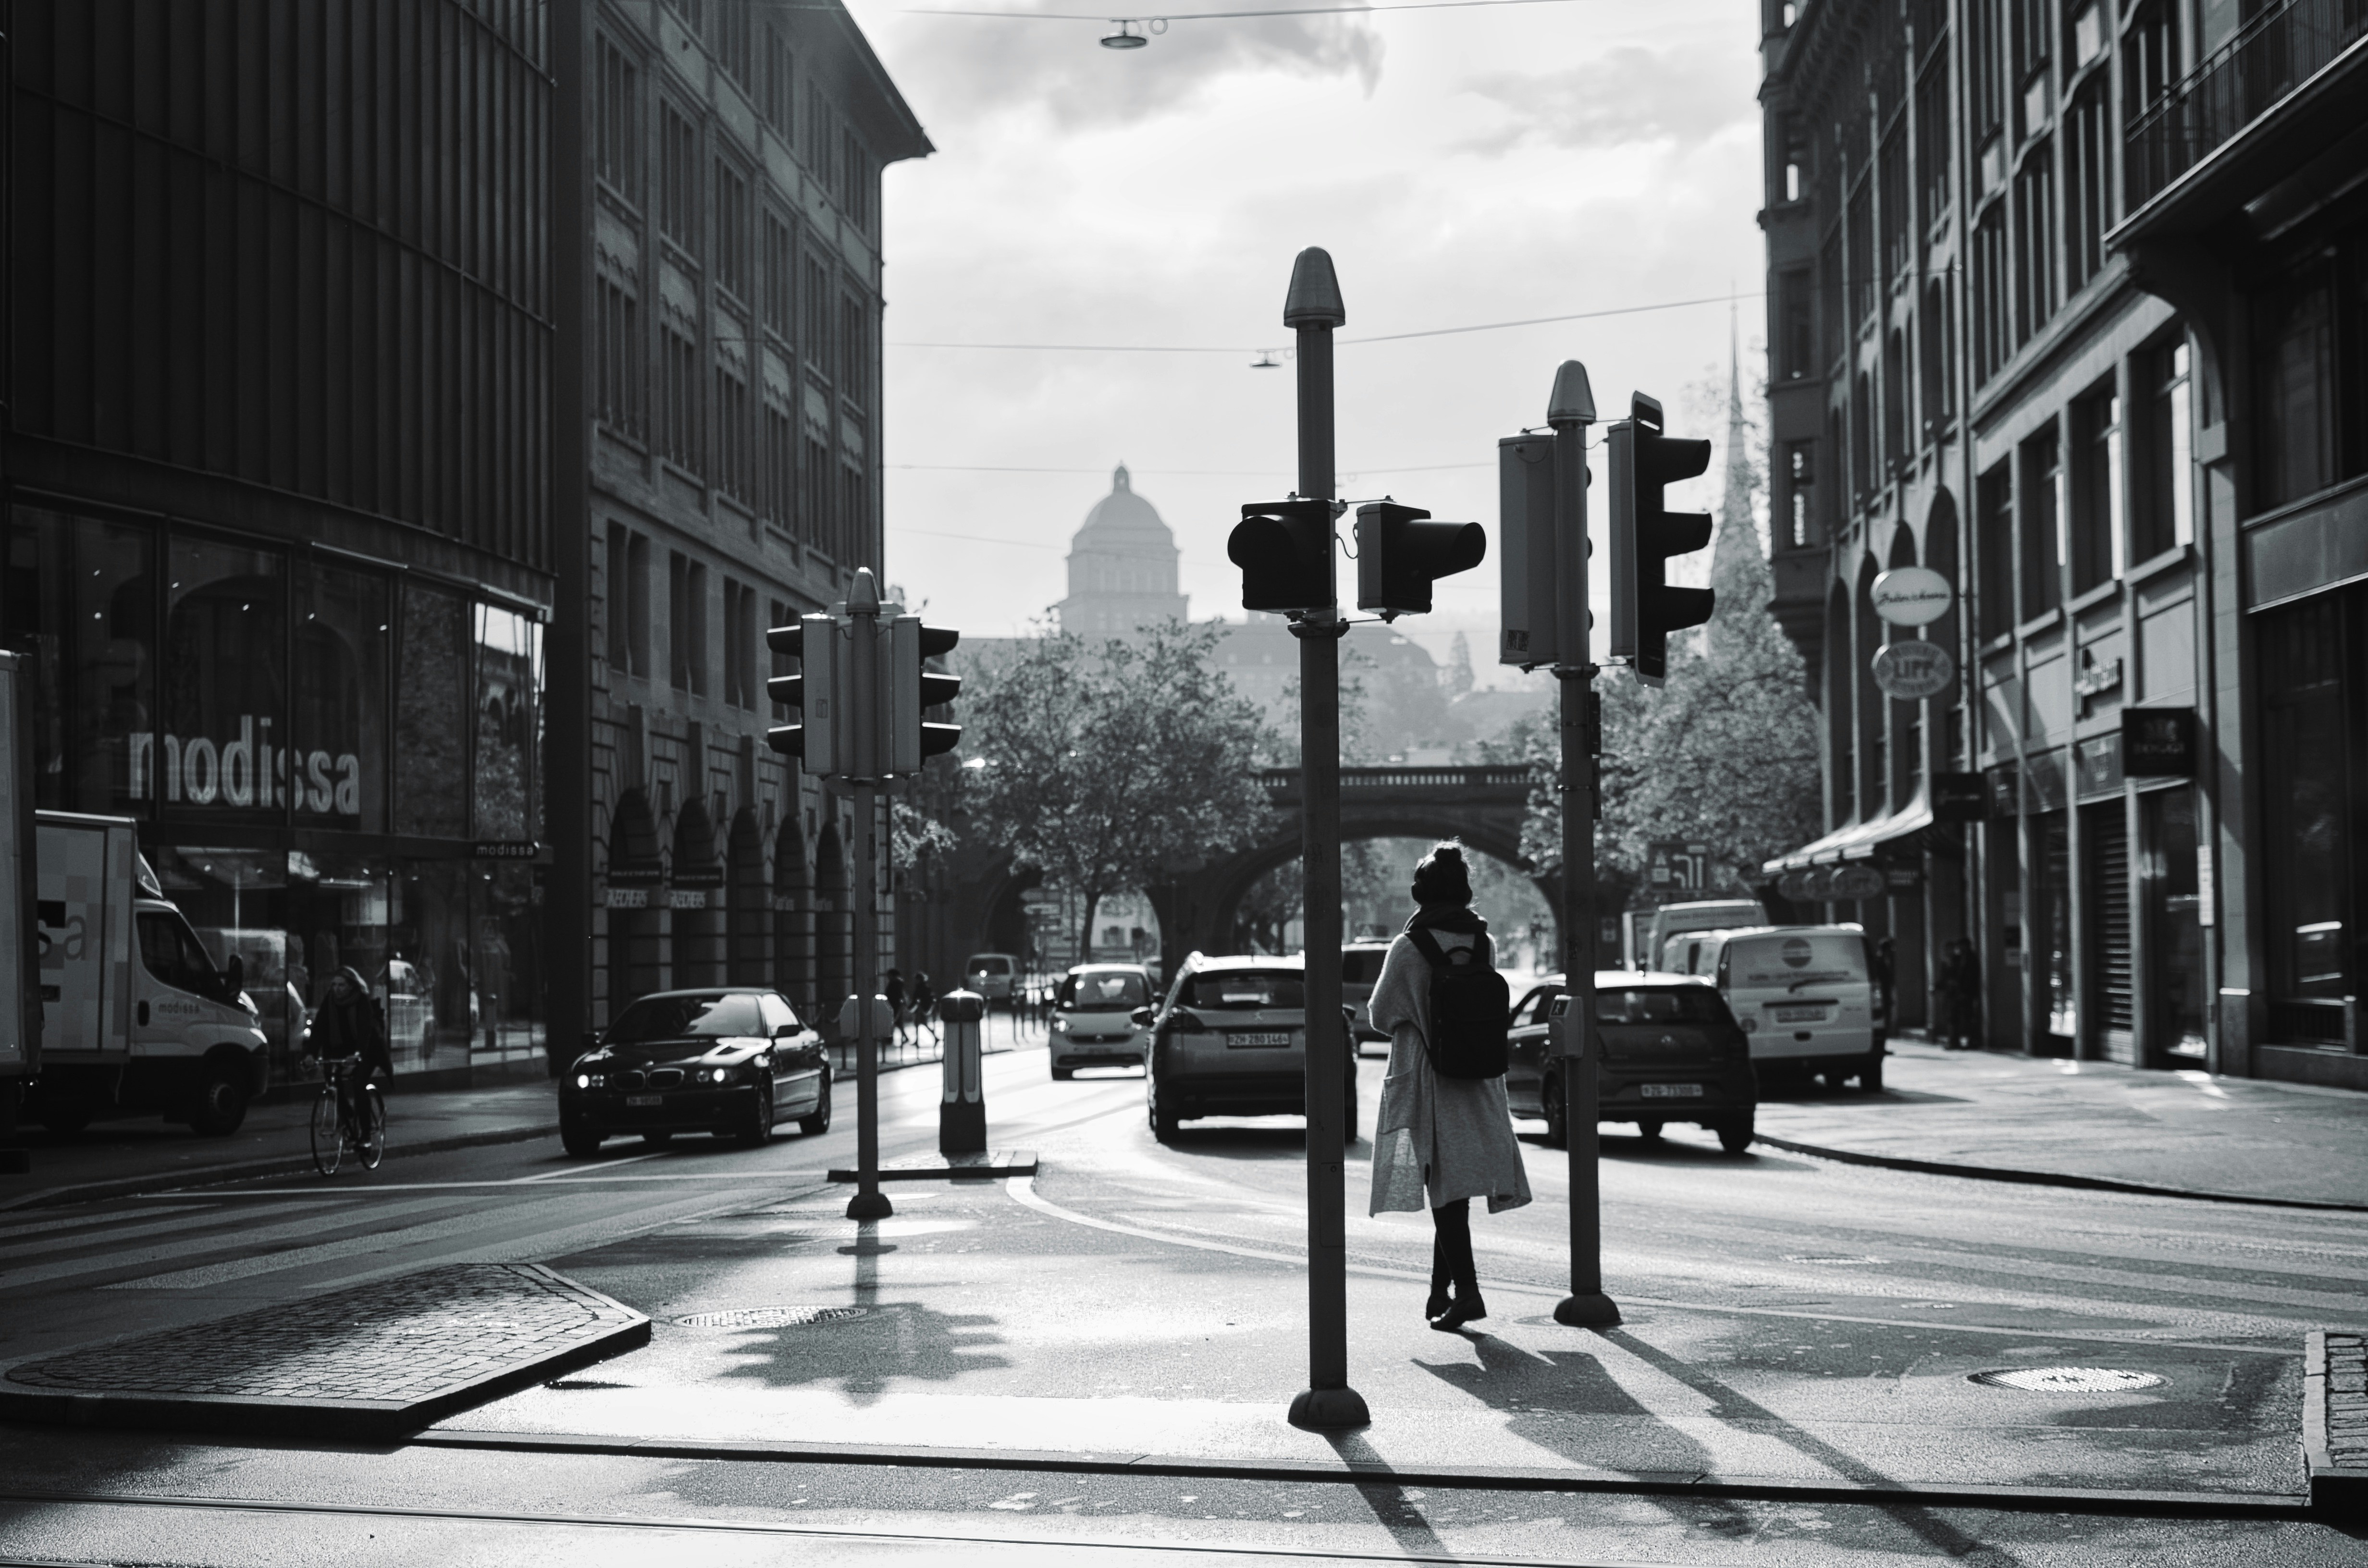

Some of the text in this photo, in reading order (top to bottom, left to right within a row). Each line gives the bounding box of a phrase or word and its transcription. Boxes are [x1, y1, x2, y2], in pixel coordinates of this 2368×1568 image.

[129, 714, 360, 815] modissa
[477, 844, 533, 856] modissa
[158, 1001, 199, 1014] modissa
